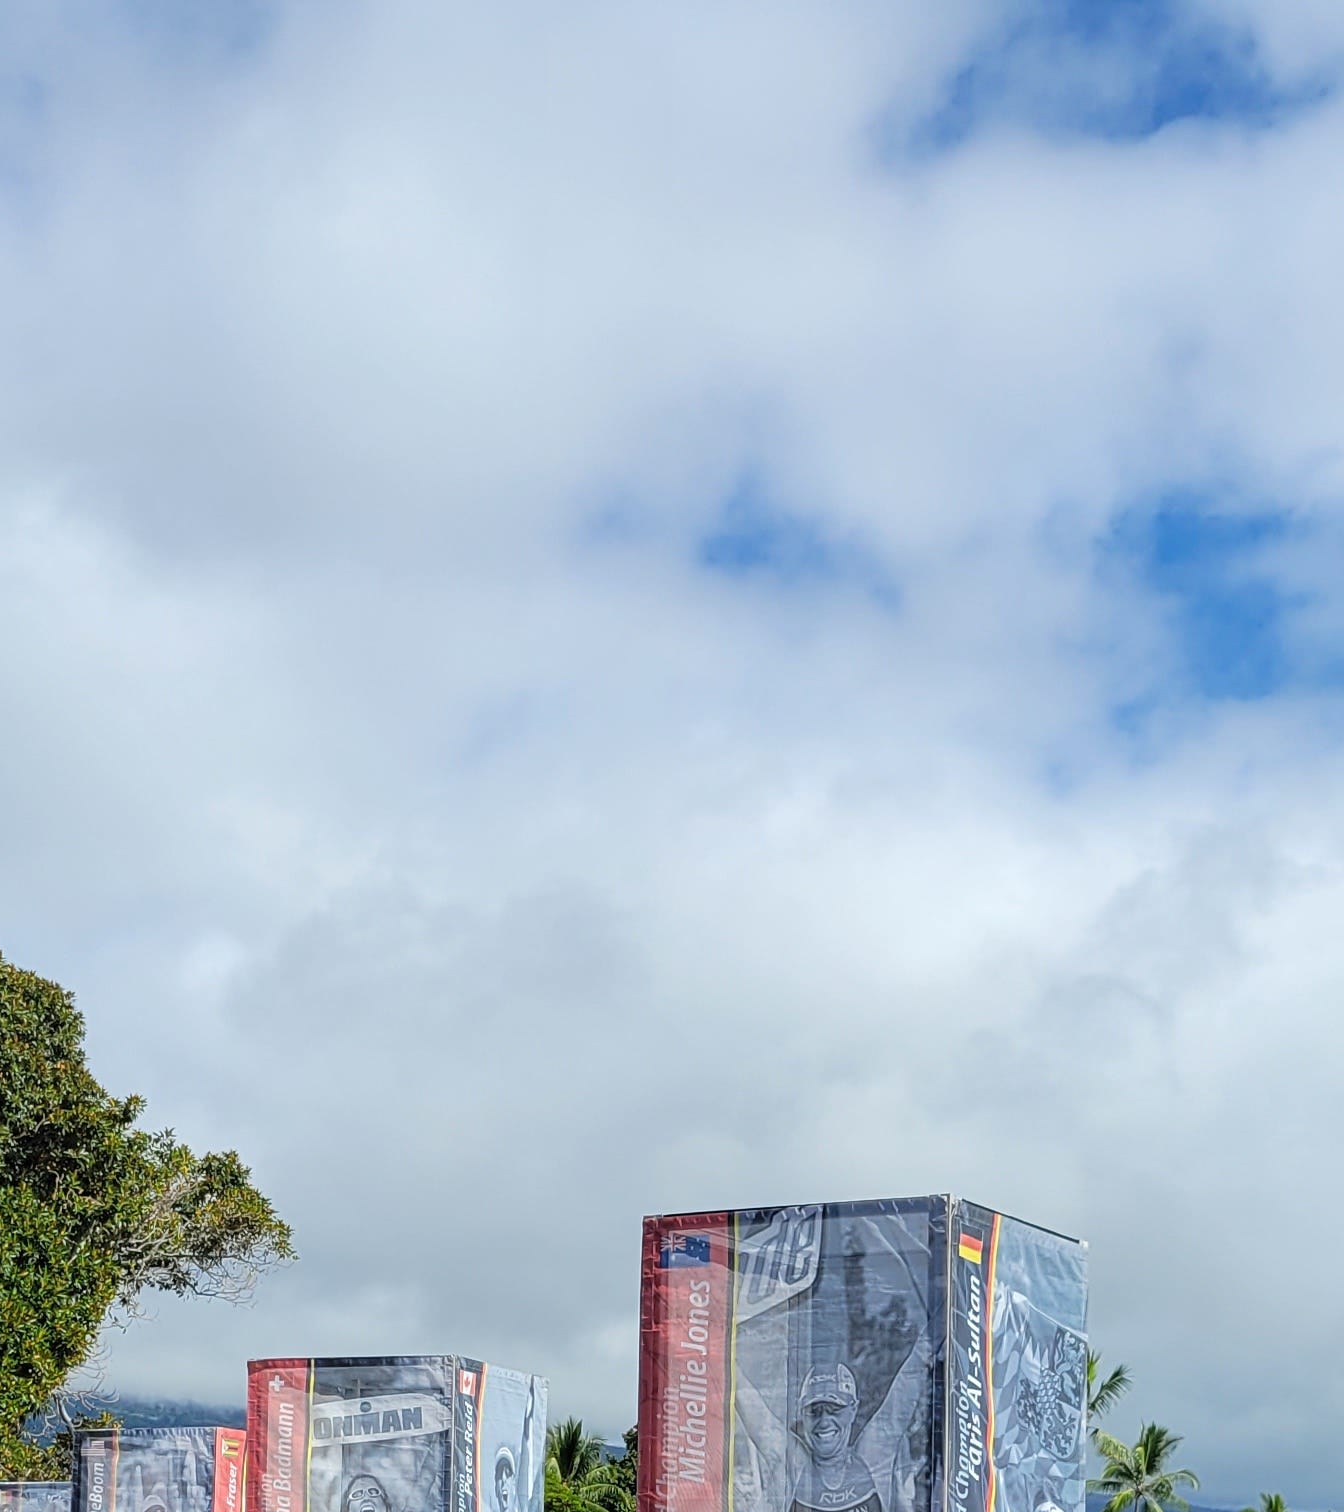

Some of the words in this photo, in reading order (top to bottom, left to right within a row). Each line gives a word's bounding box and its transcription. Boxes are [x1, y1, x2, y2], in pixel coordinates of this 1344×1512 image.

[680, 1279, 711, 1356] Jones
[967, 1275, 982, 1409] Al-Sultan
[273, 1402, 294, 1491] Badmann
[464, 1401, 474, 1439] Reid
[656, 1386, 679, 1499] Champion
[678, 1360, 707, 1484] Michellie
[955, 1380, 970, 1500] Champion
[967, 1421, 982, 1481] Faris
[463, 1442, 474, 1496] Peter
